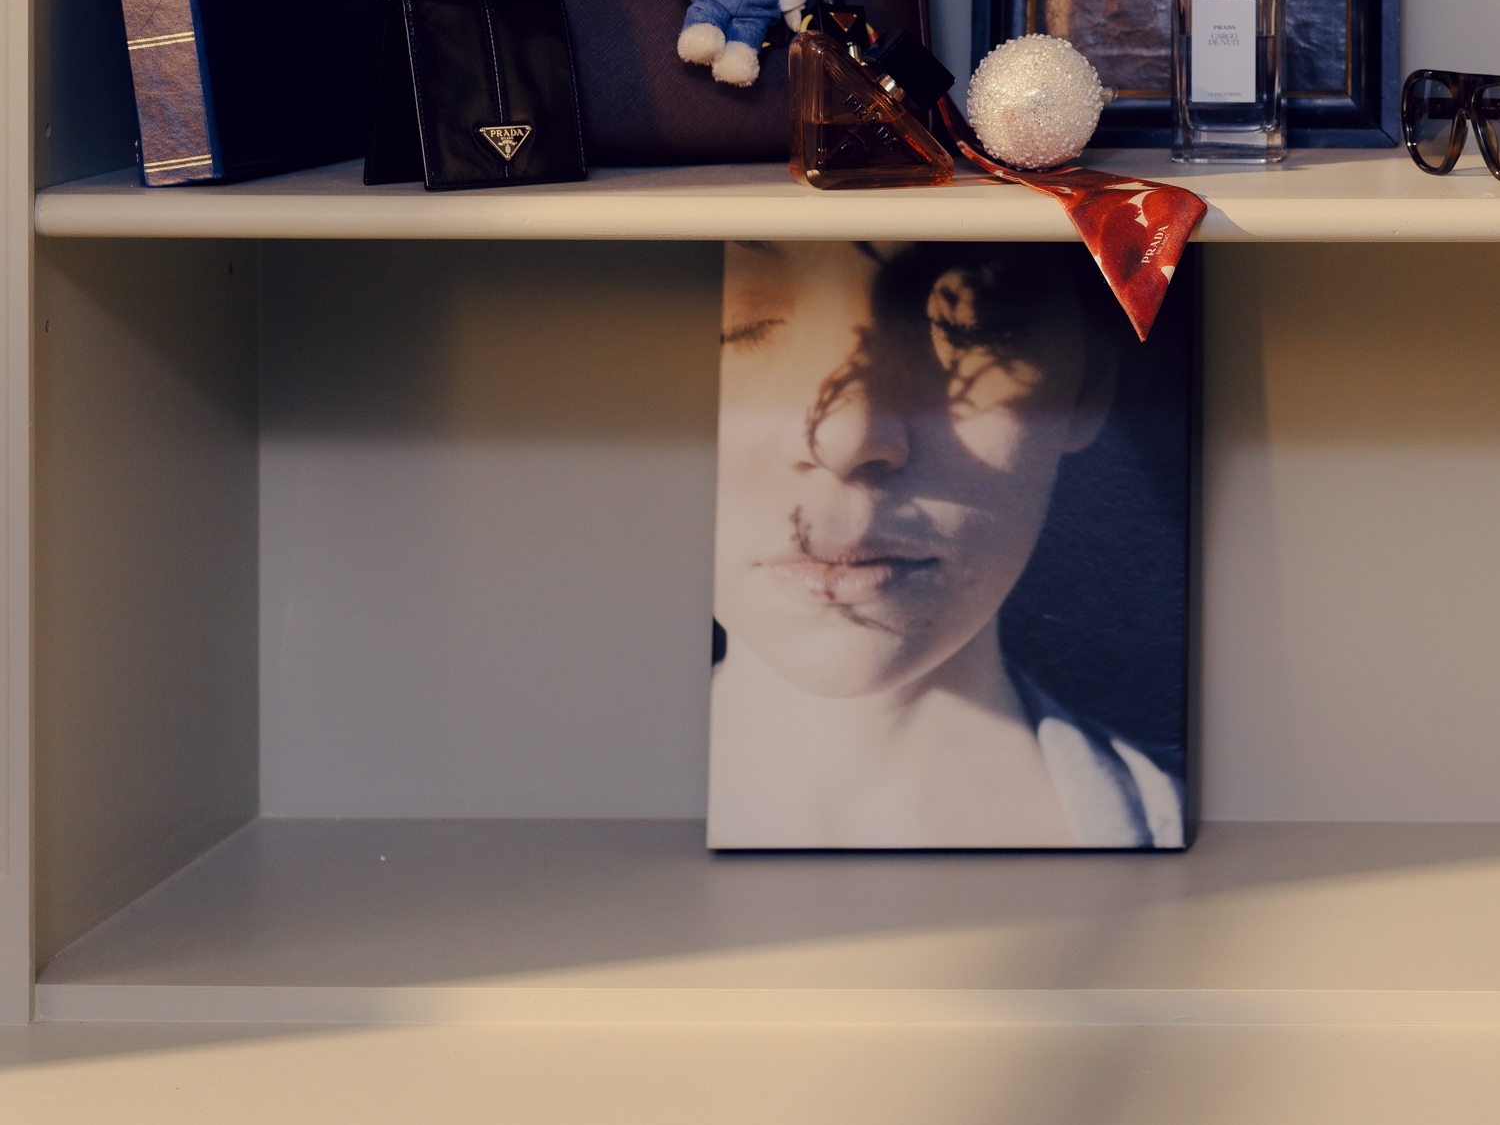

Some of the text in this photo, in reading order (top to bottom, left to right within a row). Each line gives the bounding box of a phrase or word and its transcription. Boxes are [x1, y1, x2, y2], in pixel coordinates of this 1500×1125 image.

[490, 129, 524, 137] PRADA
[843, 94, 898, 152] PRADA
[1141, 225, 1169, 263] PRADA
